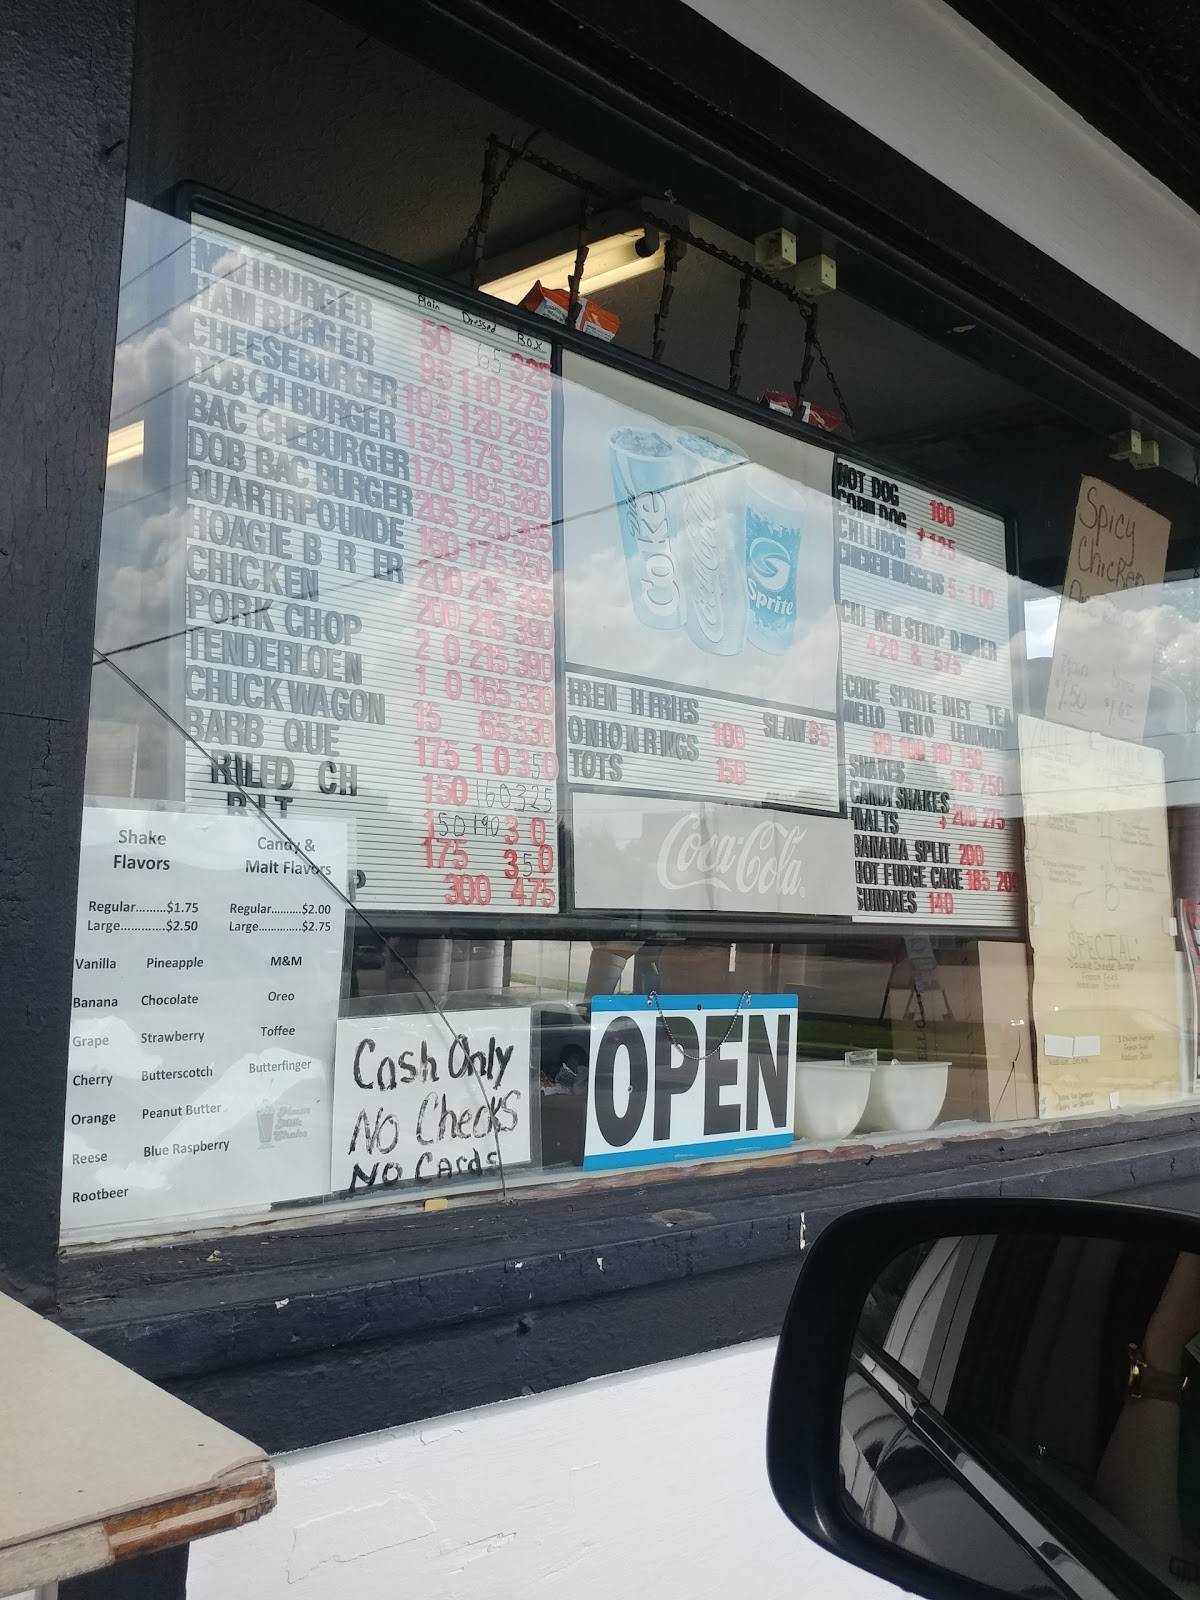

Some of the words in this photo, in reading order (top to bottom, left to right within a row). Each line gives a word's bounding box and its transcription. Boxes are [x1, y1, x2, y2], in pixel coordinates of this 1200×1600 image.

[418, 294, 440, 311] Plain
[462, 311, 497, 333] Dressed
[190, 313, 398, 408] CHEESEBURGER
[189, 389, 247, 434] BAC
[291, 381, 397, 443] BURGER
[188, 427, 247, 472] DOB
[256, 444, 309, 488] BAC
[316, 462, 414, 516] BURGER
[871, 476, 900, 507] DOG
[468, 504, 511, 541] 220
[929, 499, 956, 528] 100
[1079, 486, 1136, 567] Spicy
[186, 544, 319, 602] CHICKEN
[1078, 536, 1145, 592] Chicken
[746, 578, 793, 615] Sprite
[188, 584, 275, 633] PORK
[285, 603, 362, 646] CHOP
[470, 640, 510, 674] 215
[185, 664, 386, 725] CHUCKWAGON
[186, 707, 264, 749] BARB
[283, 719, 340, 756] QUE
[568, 715, 640, 753] ONION
[644, 727, 700, 761] RINGS
[713, 720, 746, 750] 100
[415, 736, 459, 770] 175
[568, 748, 623, 782] TOTS
[318, 761, 358, 796] CH
[715, 756, 747, 785] 150
[849, 754, 906, 784] SHAKES
[423, 773, 468, 806] 150
[896, 787, 951, 814] SHAKES
[851, 807, 900, 835] MALTS
[118, 829, 167, 846] Shake
[257, 836, 300, 853] Candy
[304, 838, 316, 852] &
[854, 834, 909, 861] BANANA
[914, 839, 951, 864] SPLIT
[113, 854, 171, 871] Flavors
[245, 860, 279, 874] Malt
[283, 861, 332, 875] Flavors
[423, 837, 468, 870] 175
[657, 811, 808, 896] Coca-Cola
[855, 860, 879, 885] HOT
[883, 862, 927, 889] FUDGE
[930, 866, 964, 890] CAKE
[444, 873, 491, 905] 300
[511, 877, 556, 908] 475
[856, 886, 918, 913] SUNDAES
[75, 957, 117, 970] Vanilla
[146, 956, 204, 970] Pineapple
[270, 956, 303, 967] M&M
[72, 996, 118, 1008] Banana
[140, 994, 199, 1006] Chocolate
[267, 991, 295, 1002] Oreo
[72, 1035, 110, 1049] Grape
[140, 1031, 205, 1045] Strawberry
[260, 1025, 296, 1037] Toffee
[141, 1066, 213, 1082] Butterscotch
[249, 1059, 312, 1074] Butterfinger
[353, 1038, 440, 1091] Cash
[448, 1034, 515, 1090] Only
[72, 1073, 113, 1087] Cherry
[594, 1014, 791, 1148] OPEN
[71, 1112, 117, 1126] Orange
[142, 1106, 183, 1120] Peanut
[185, 1103, 222, 1116] Butter
[72, 1152, 108, 1165] Reese
[143, 1144, 169, 1158] Blue
[172, 1140, 230, 1156] Raspberry
[72, 1187, 129, 1203] Rootbeer
